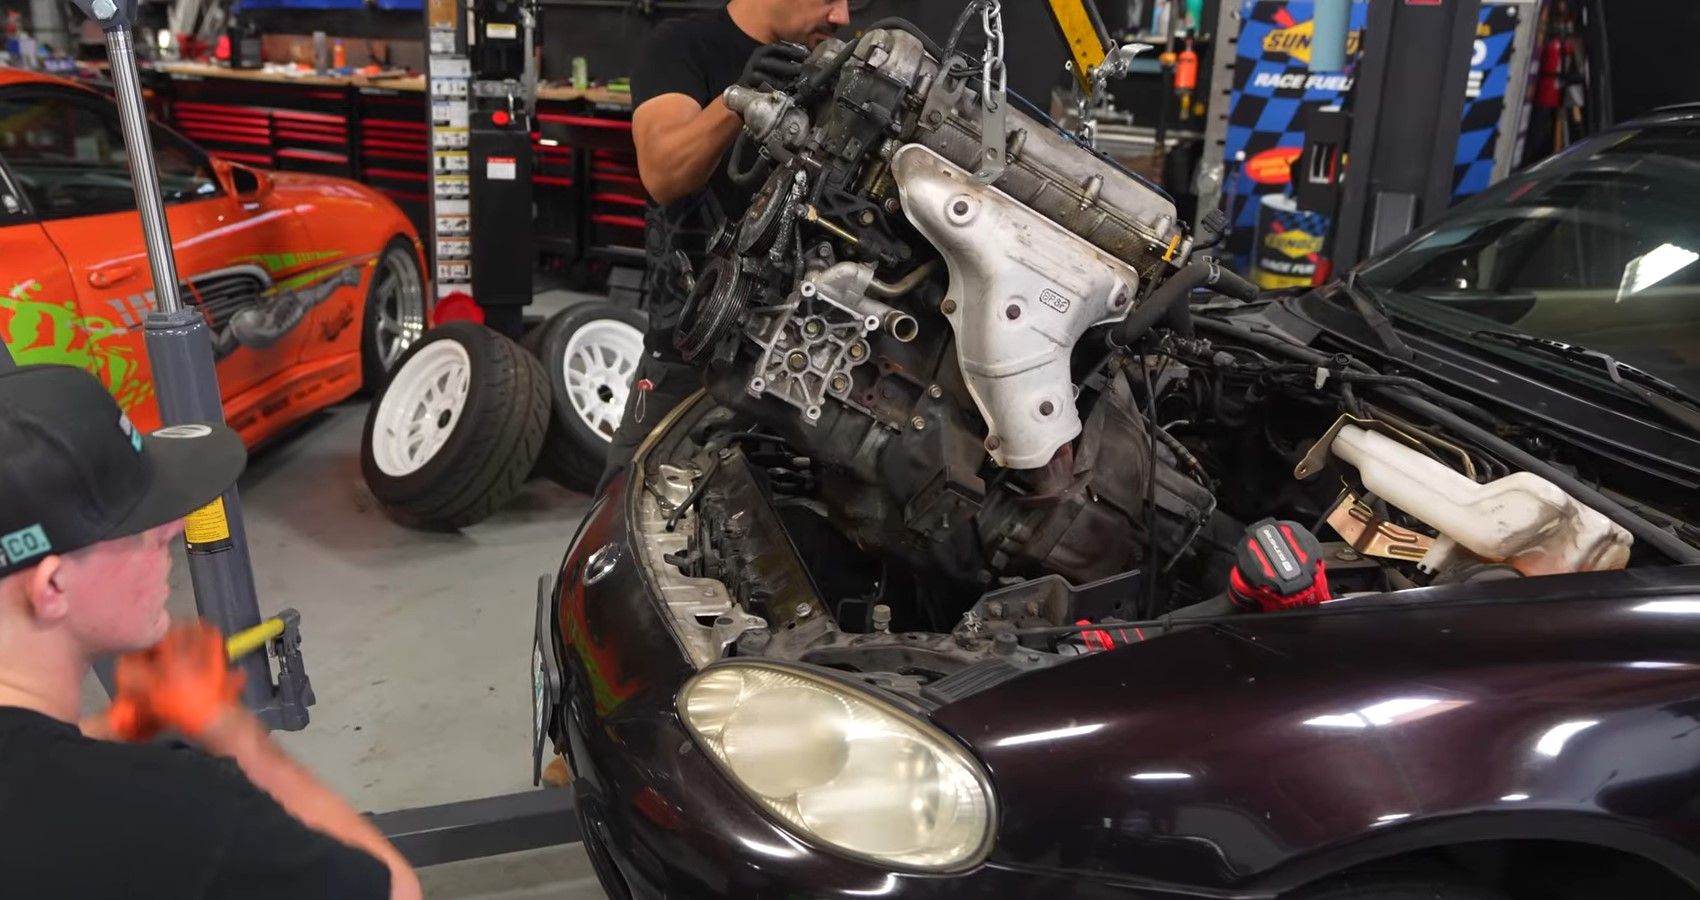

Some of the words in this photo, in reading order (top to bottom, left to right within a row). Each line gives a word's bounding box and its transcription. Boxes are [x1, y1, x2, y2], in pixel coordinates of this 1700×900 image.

[1268, 32, 1358, 52] SUNO
[1254, 73, 1306, 89] RACE
[7, 532, 46, 557] CO.
